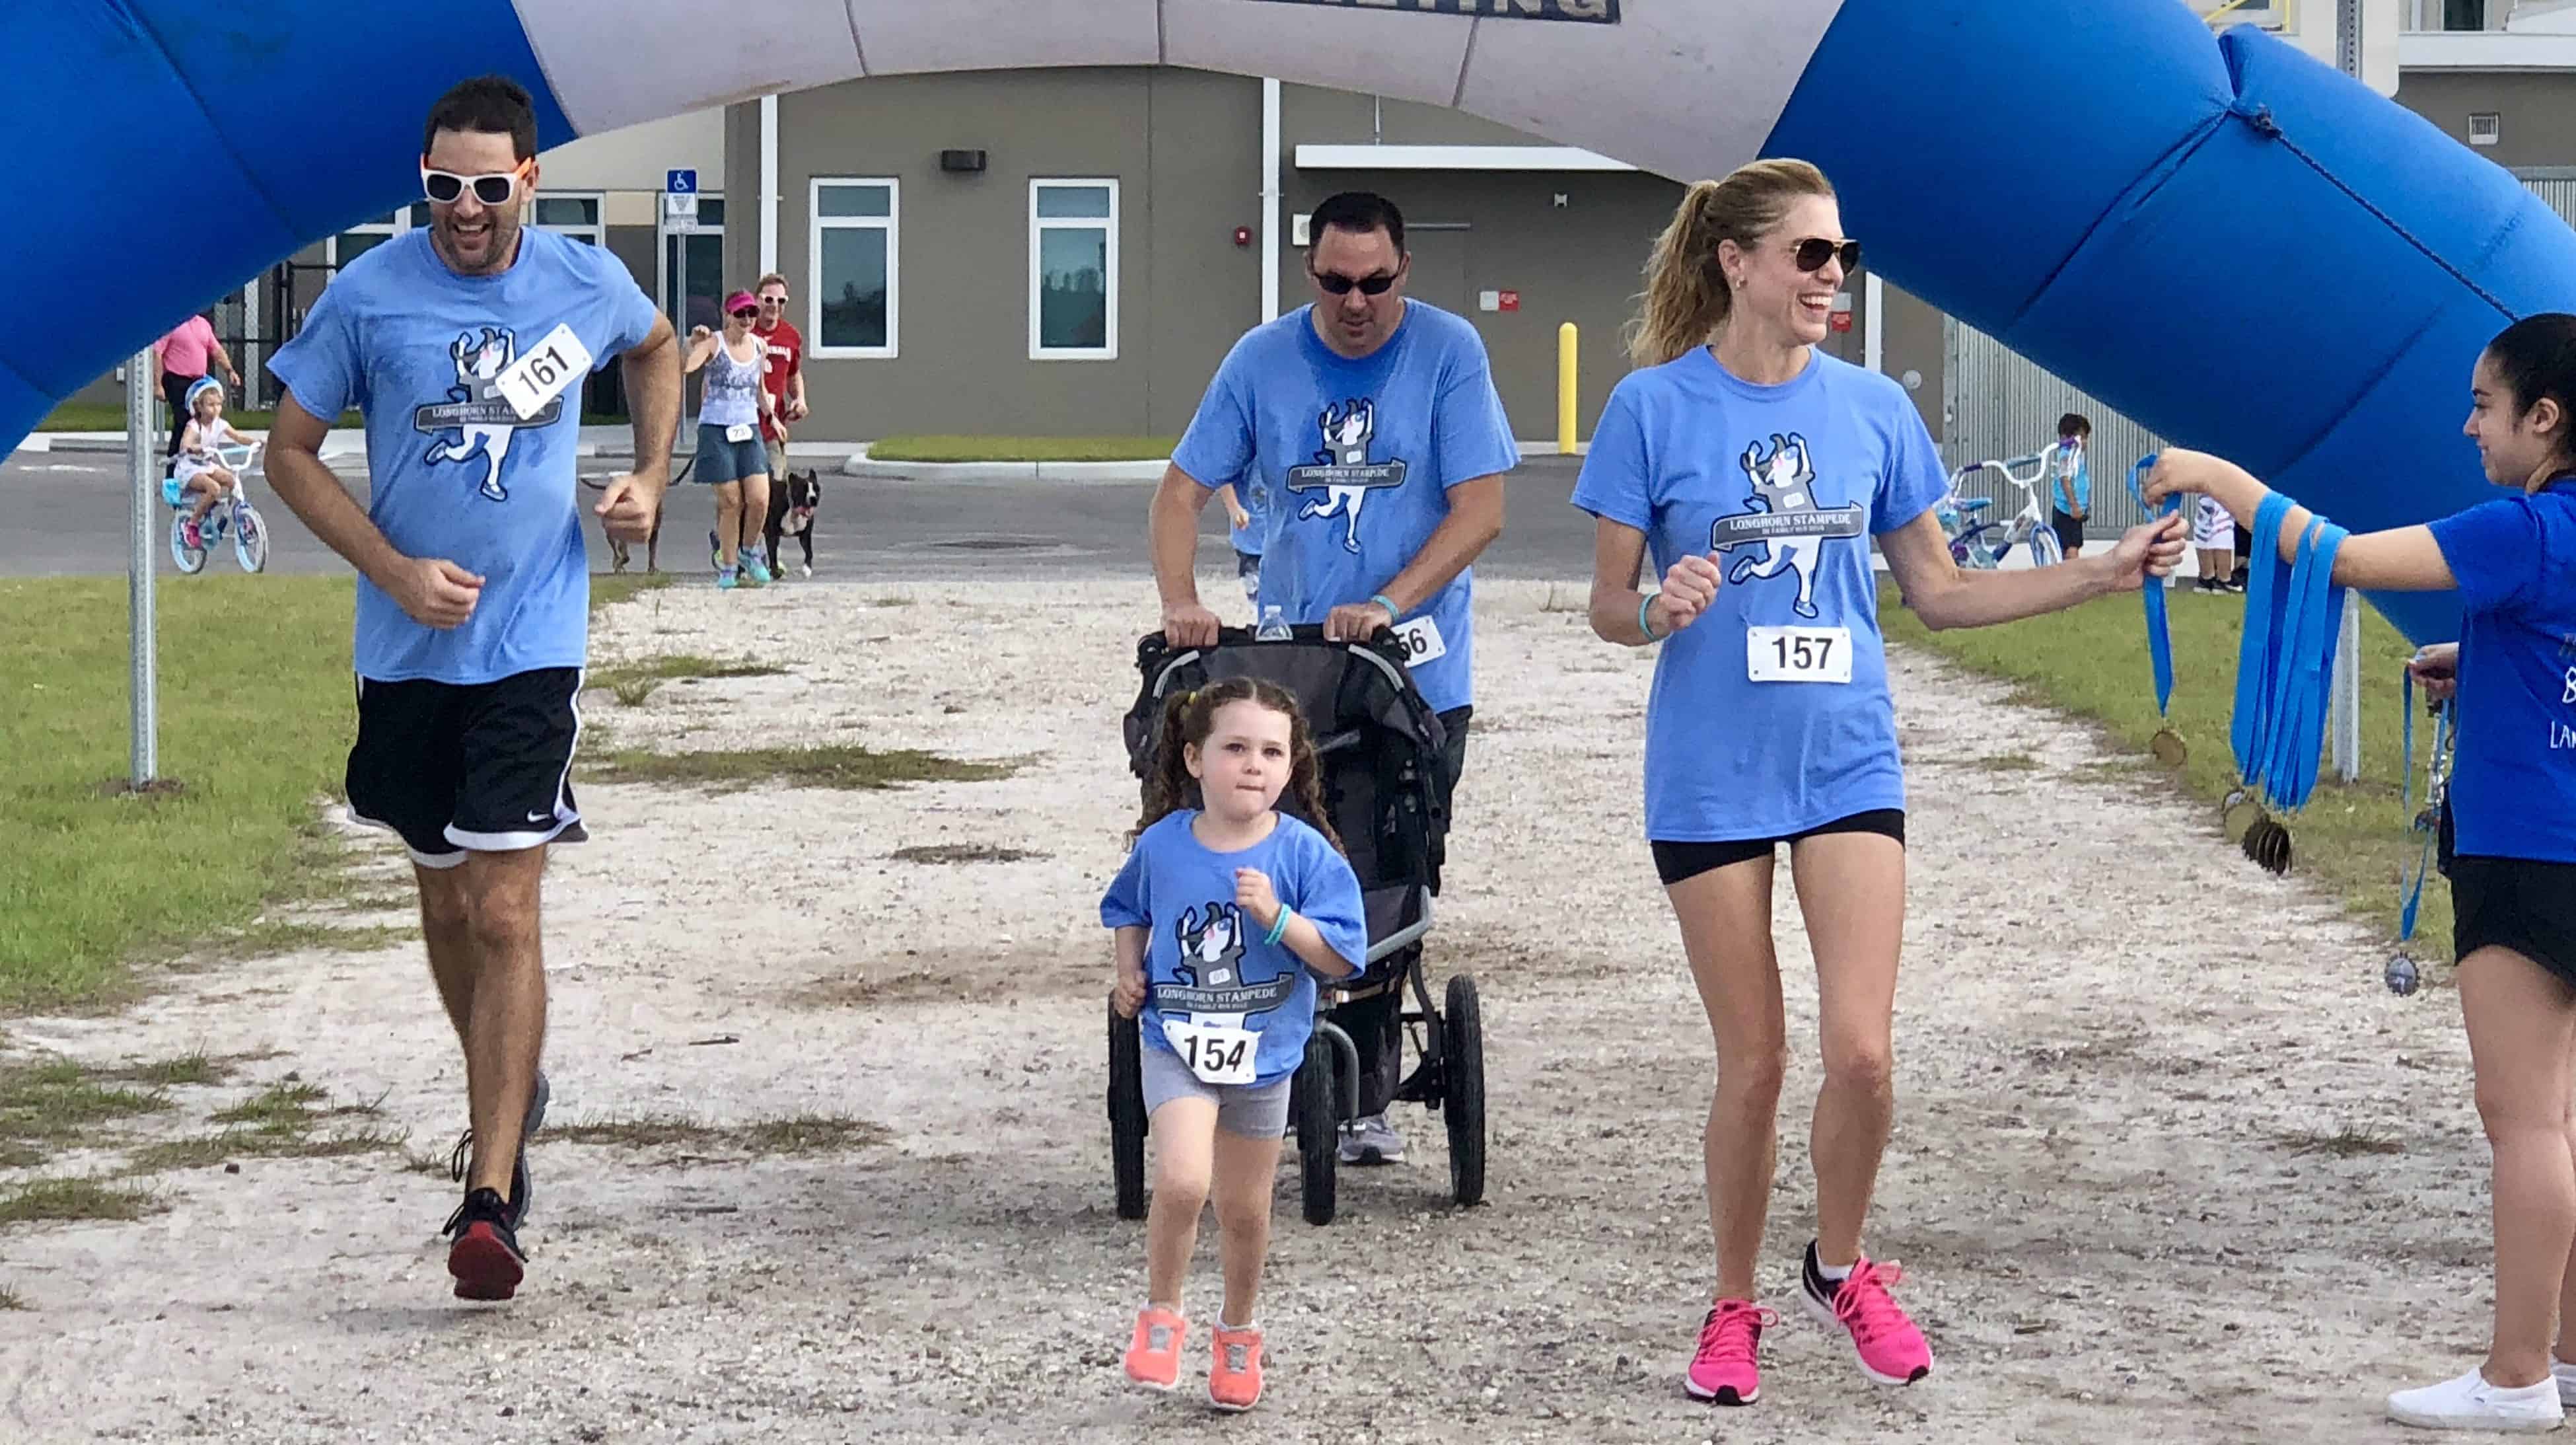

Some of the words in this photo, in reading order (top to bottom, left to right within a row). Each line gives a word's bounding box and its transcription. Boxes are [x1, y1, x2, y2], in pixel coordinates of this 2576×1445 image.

[519, 346, 569, 396] 161
[432, 405, 486, 418] LONGHORN
[1730, 516, 1791, 530] LONGHORN
[1793, 513, 1851, 526] STAMPEDE
[1398, 628, 1428, 658] 56
[1771, 636, 1834, 670] 157
[1157, 988, 1214, 1003] LONGHORN
[1216, 987, 1277, 1002] STAMPEDE
[1184, 1035, 1246, 1072] 154
